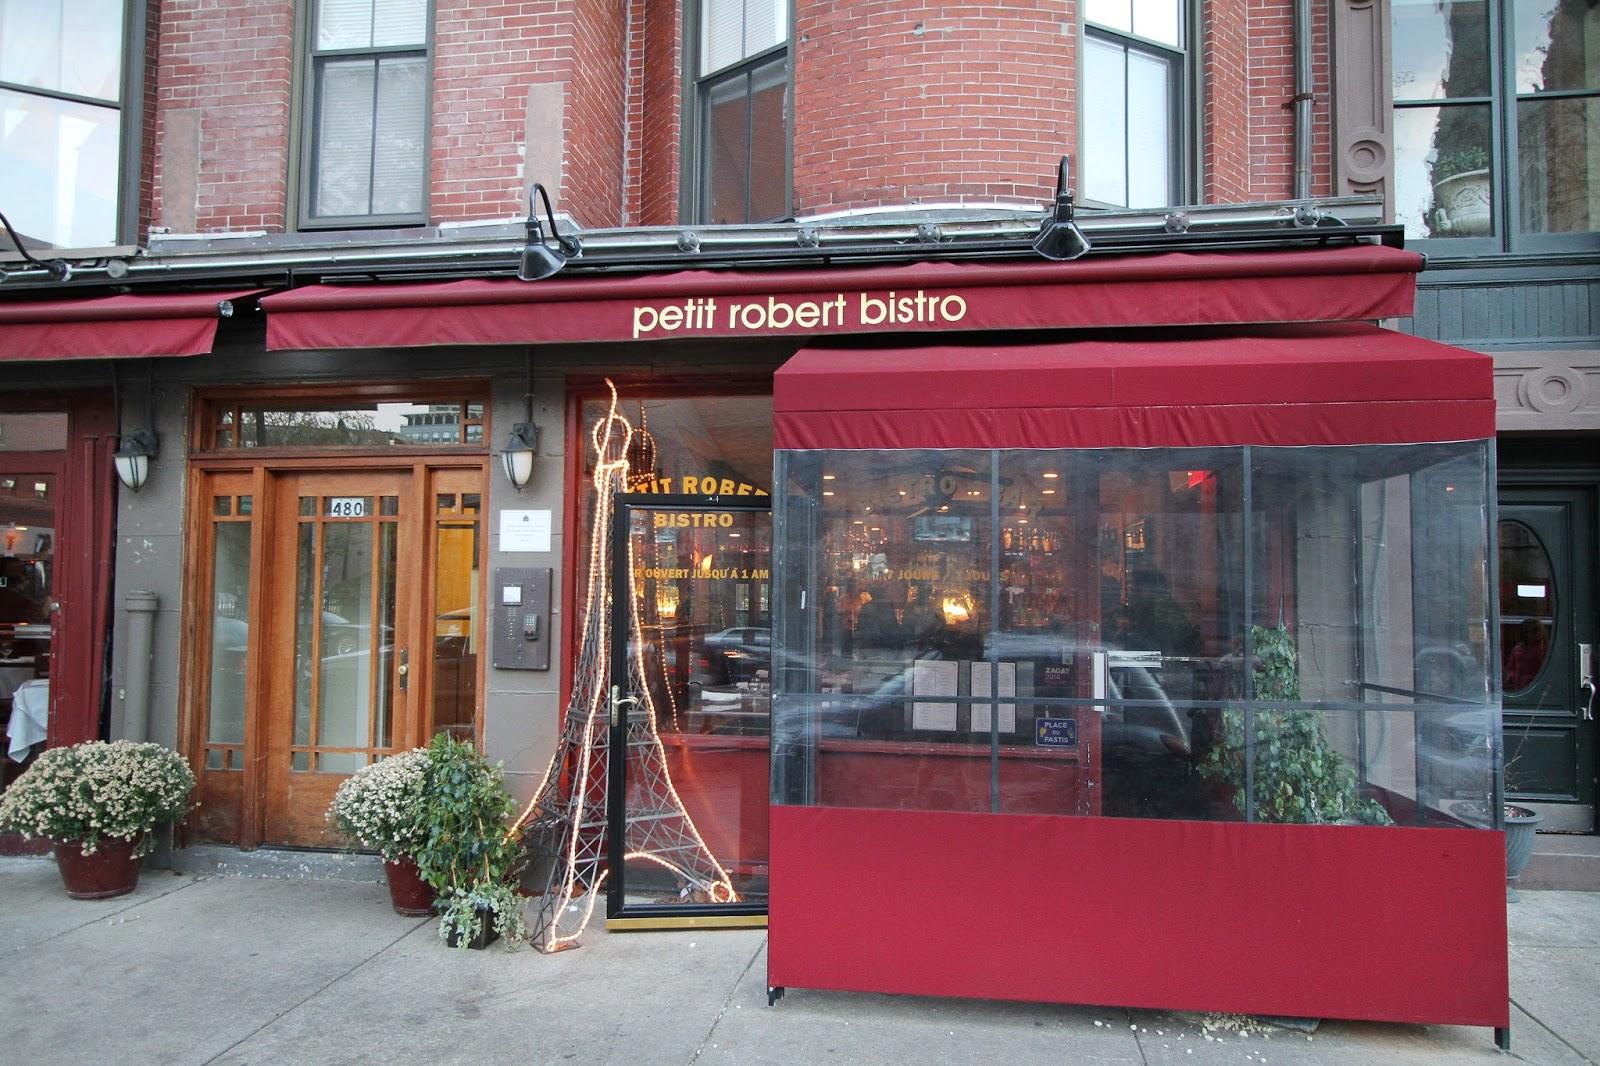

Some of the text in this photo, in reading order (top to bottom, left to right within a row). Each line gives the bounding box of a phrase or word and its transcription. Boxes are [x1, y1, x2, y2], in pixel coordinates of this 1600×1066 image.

[633, 290, 967, 338] petit robert bistro
[683, 476, 769, 496] ROBE
[333, 502, 363, 516] 480
[655, 513, 734, 527] BISTRO
[645, 569, 689, 579] OUVERT
[742, 569, 748, 578] 1
[751, 569, 769, 578] AM
